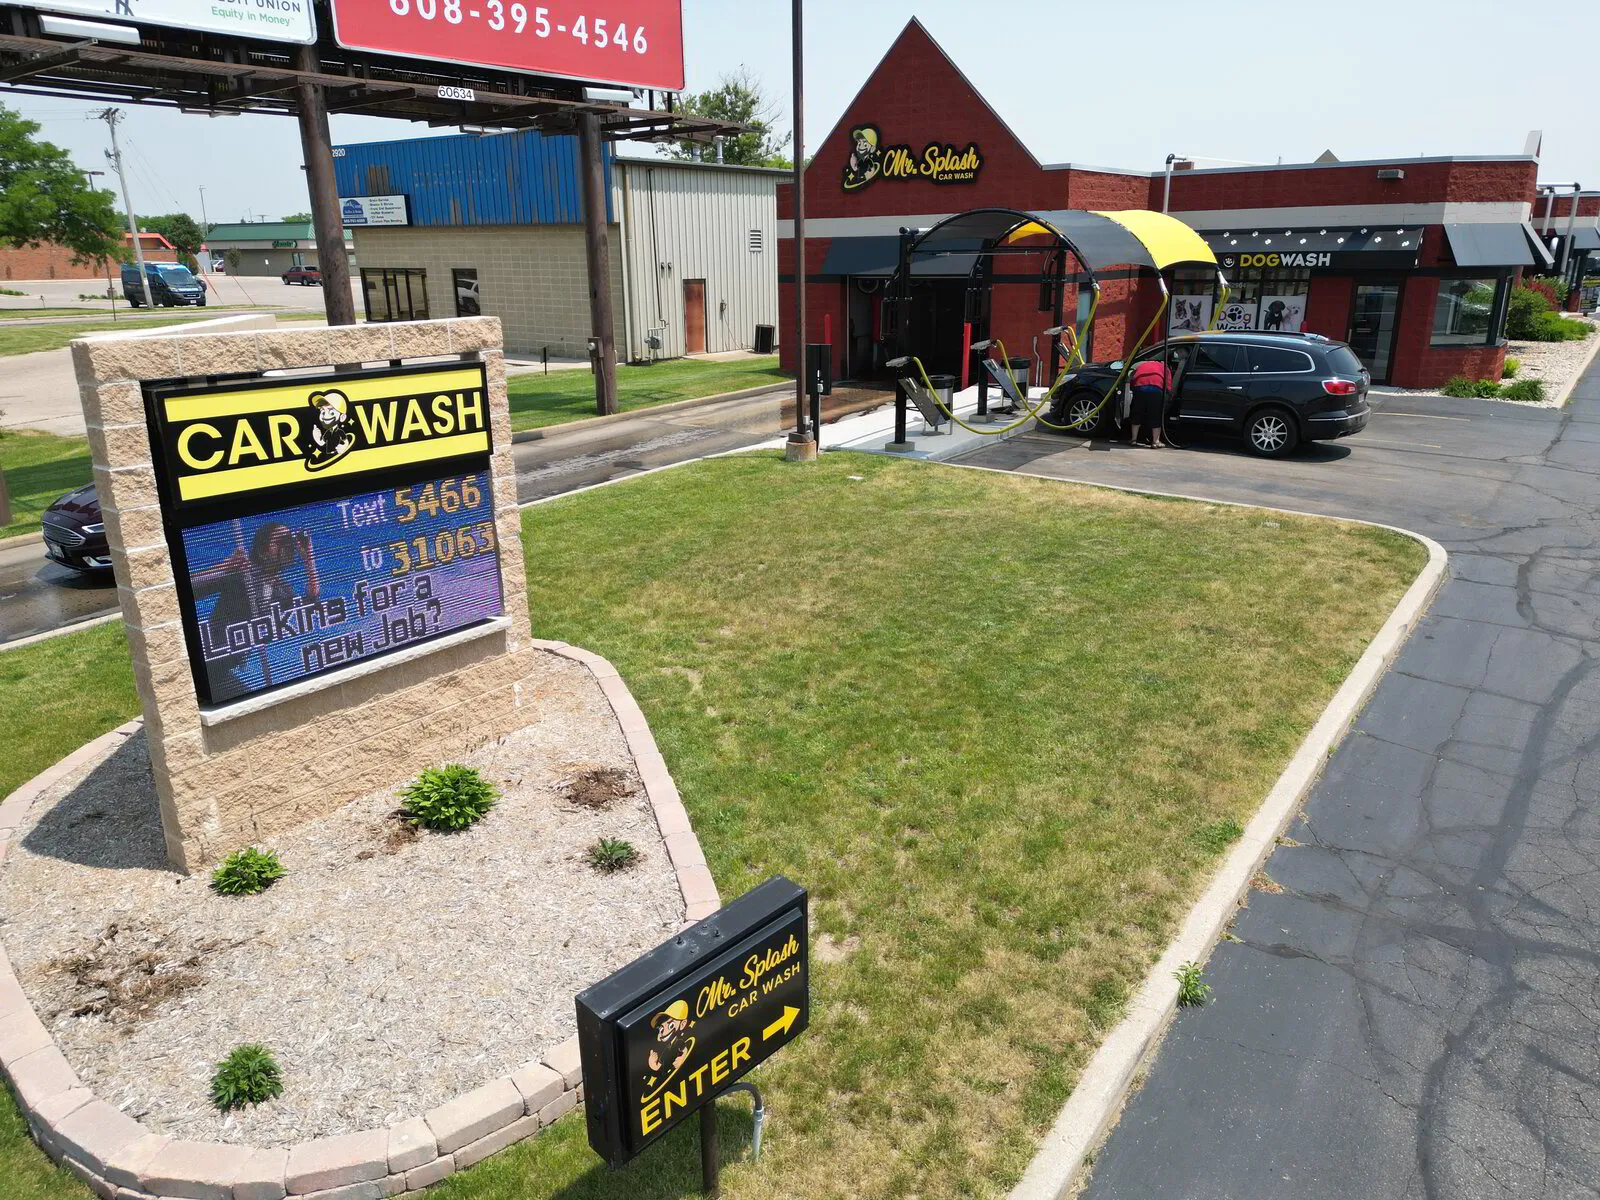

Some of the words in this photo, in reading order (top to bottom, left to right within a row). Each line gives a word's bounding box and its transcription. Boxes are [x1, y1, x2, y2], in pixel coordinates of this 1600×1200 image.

[211, 6, 244, 20] Equity
[247, 11, 257, 20] in
[256, 0, 301, 12] UNION
[439, 86, 473, 100] 60634
[883, 148, 918, 177] Mr.
[920, 146, 980, 179] Splash
[938, 173, 953, 181] CAR
[954, 172, 974, 180] WASH
[177, 414, 304, 470] CAR
[354, 391, 484, 445] WASH
[337, 494, 388, 529] Text
[395, 475, 481, 523] 5466
[389, 521, 495, 576] 31063
[353, 579, 406, 617] for
[413, 573, 433, 601] a
[301, 631, 366, 672] new
[696, 976, 737, 1018] Mr.
[739, 934, 800, 990] Splash
[728, 990, 758, 1018] CAR
[762, 961, 800, 995] WASH
[641, 1035, 751, 1137] ENTER
